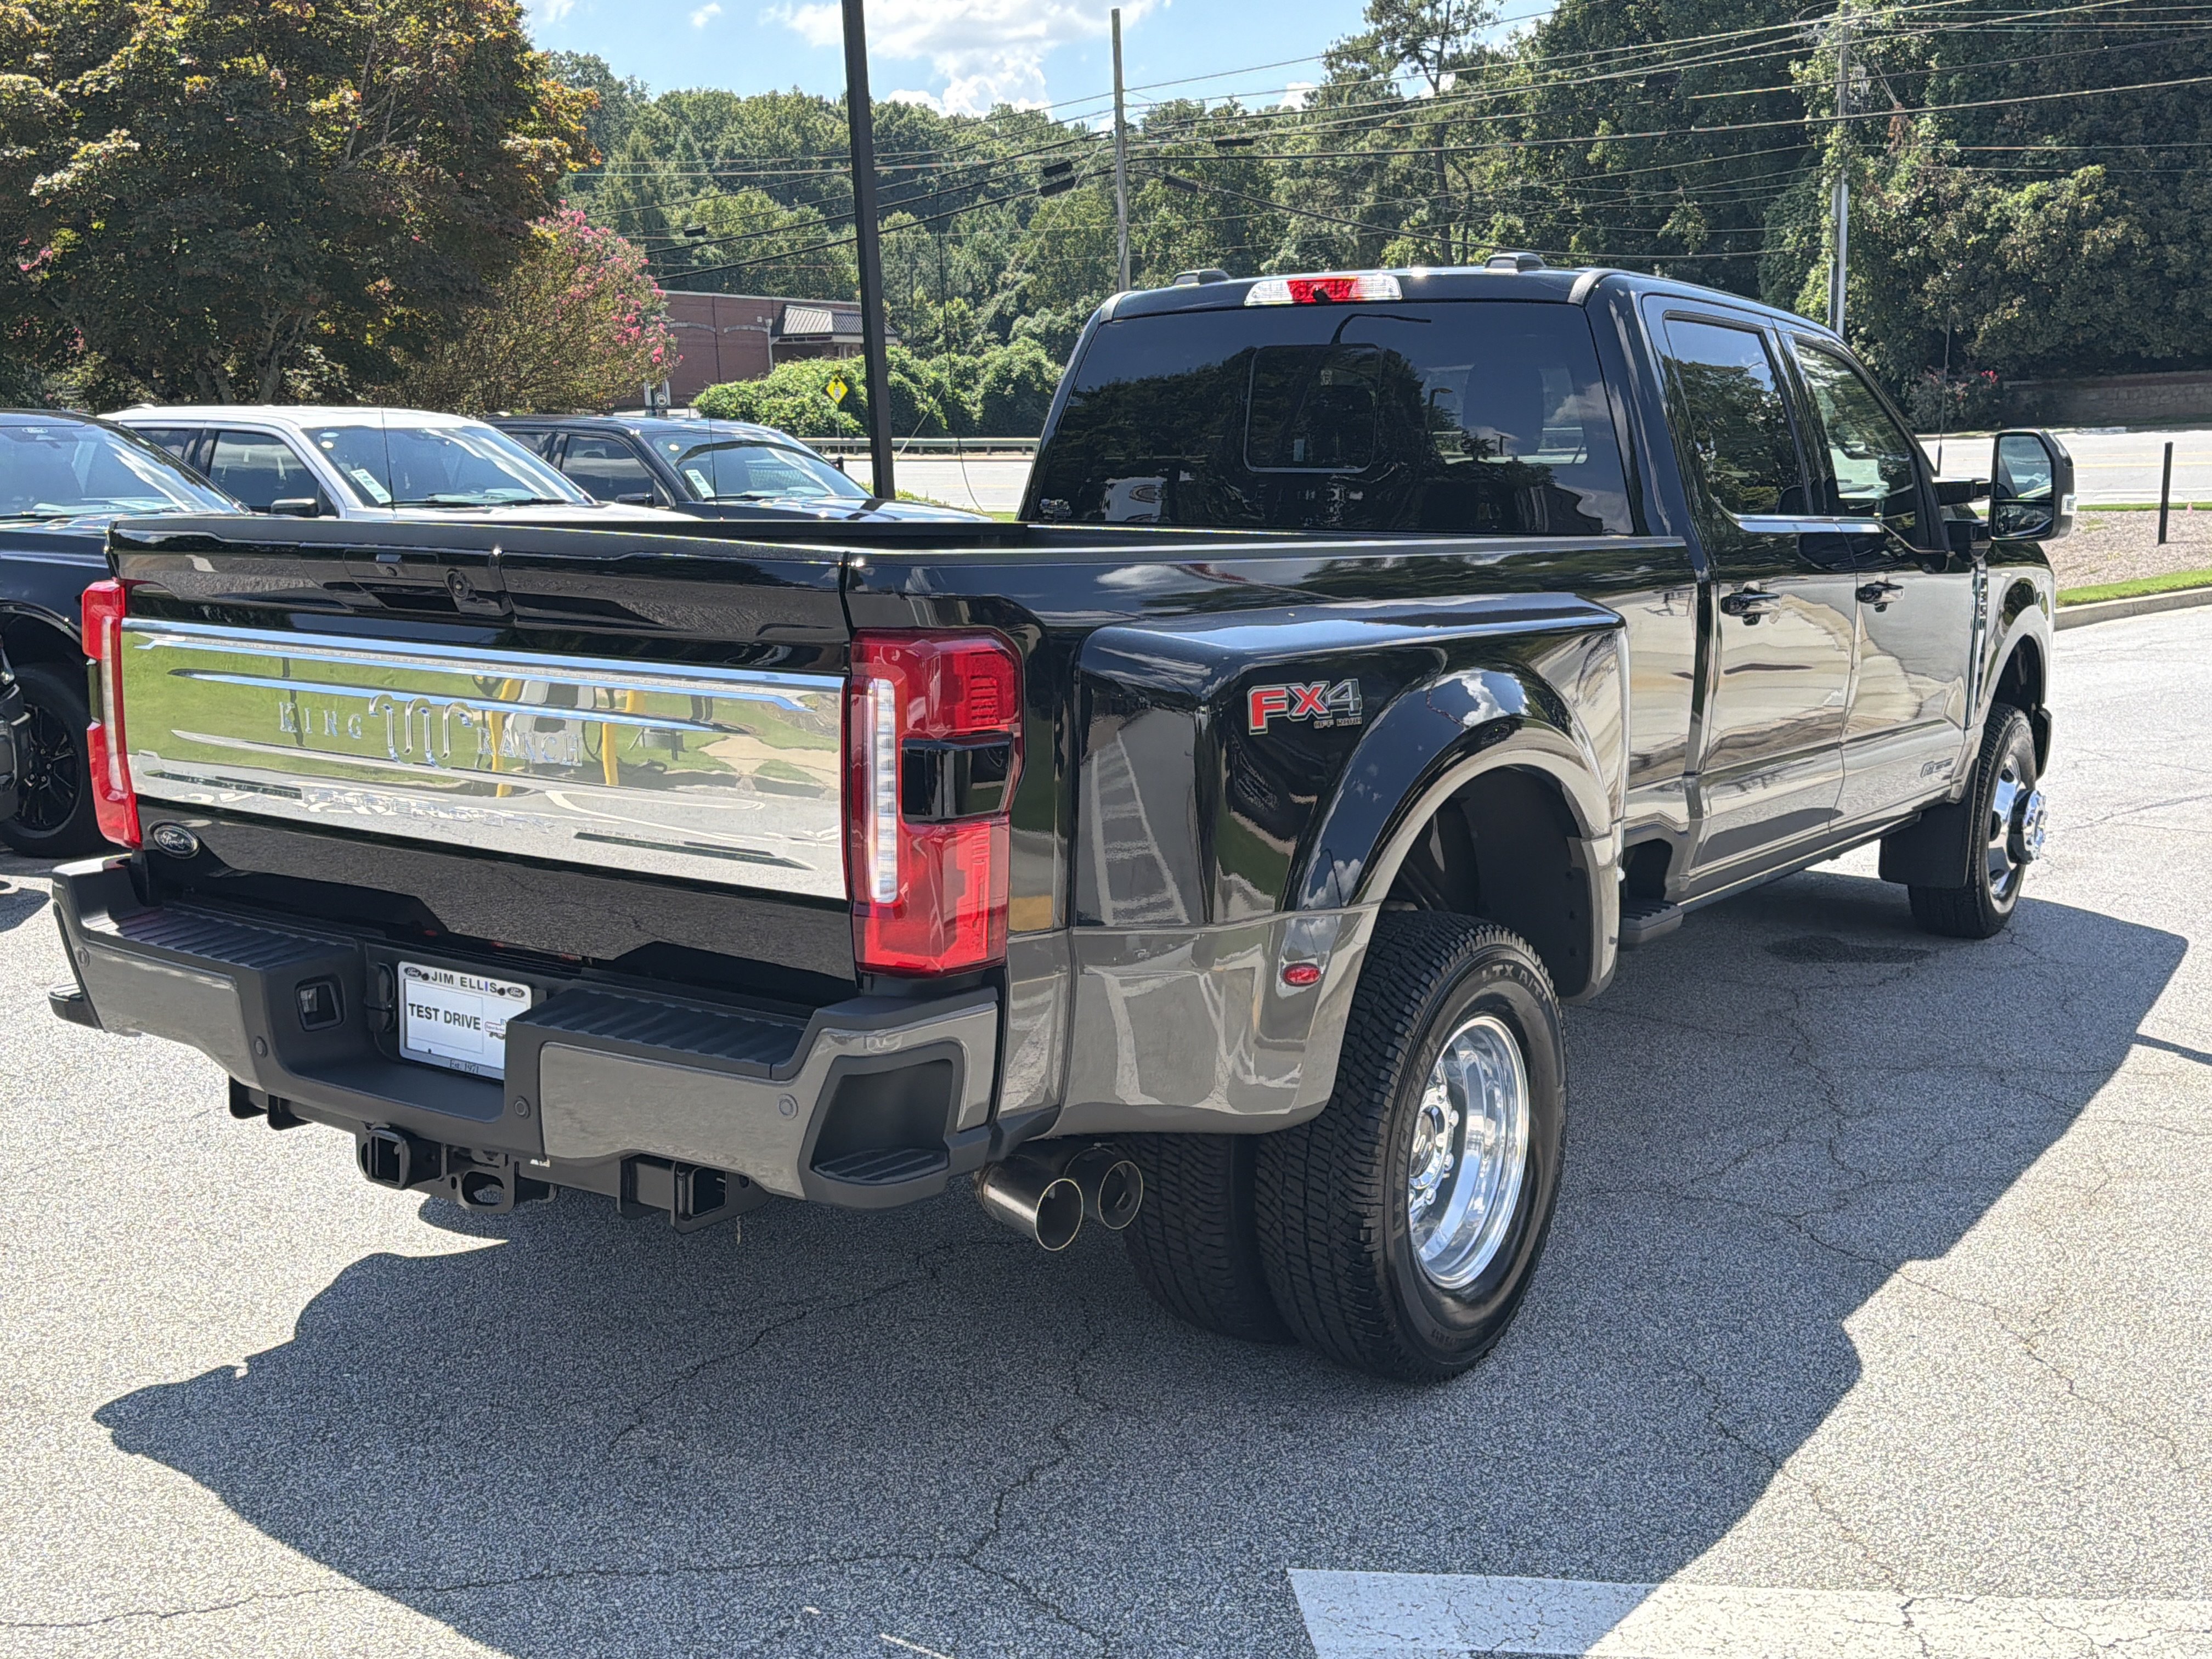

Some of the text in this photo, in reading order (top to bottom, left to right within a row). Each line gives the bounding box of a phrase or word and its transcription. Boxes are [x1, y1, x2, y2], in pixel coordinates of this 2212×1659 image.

[1248, 678, 1363, 735] FX4
[279, 701, 583, 767] KING RANCH
[431, 971, 498, 993] JIM ELLIS
[408, 1003, 440, 1020] TEST
[444, 1010, 481, 1031] DRIVE
